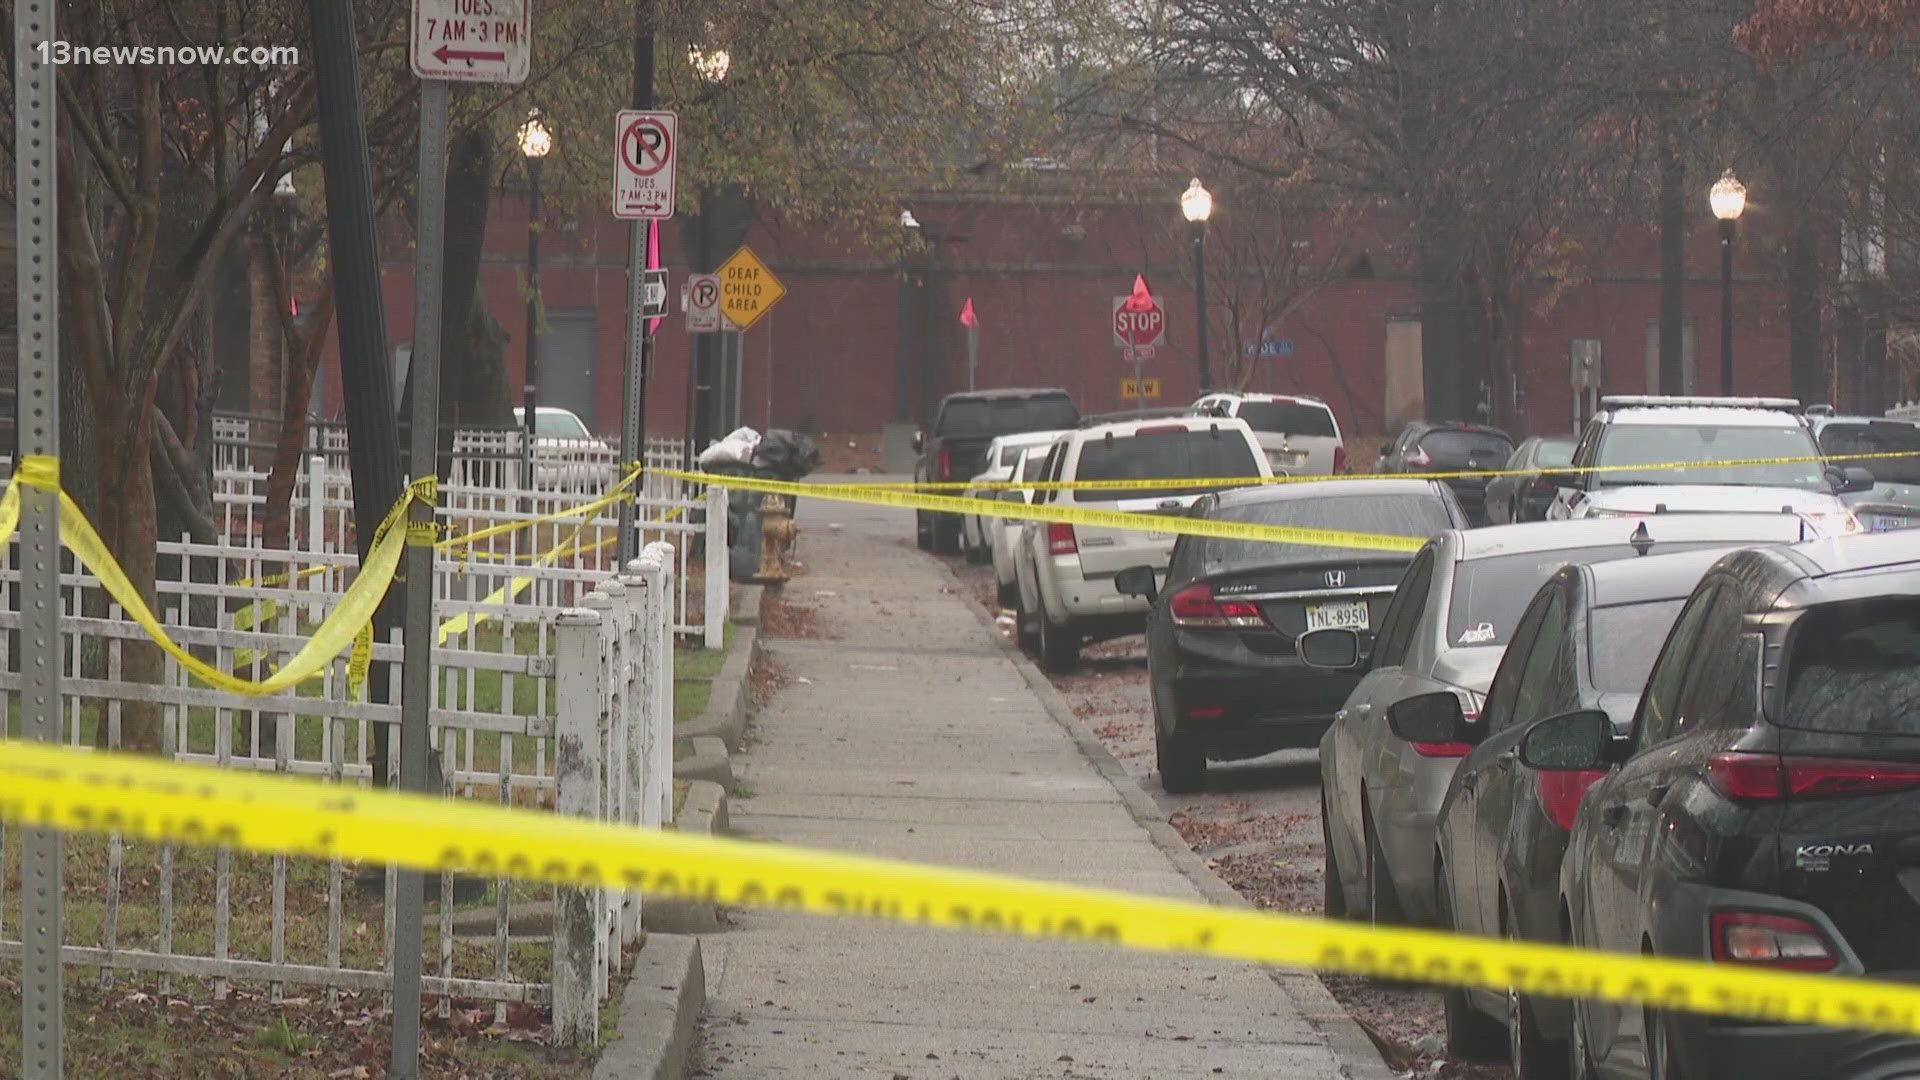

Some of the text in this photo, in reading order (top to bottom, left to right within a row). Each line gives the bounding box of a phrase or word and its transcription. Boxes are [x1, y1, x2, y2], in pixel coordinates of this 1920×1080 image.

[634, 178, 658, 189] TUES.
[728, 267, 760, 279] DEAF
[724, 284, 762, 296] CHILD
[727, 299, 758, 311] AREA
[1117, 311, 1161, 332] STOP
[1126, 383, 1154, 395] NW
[1310, 607, 1367, 627] TNL-8950
[1795, 843, 1874, 858] KONA
